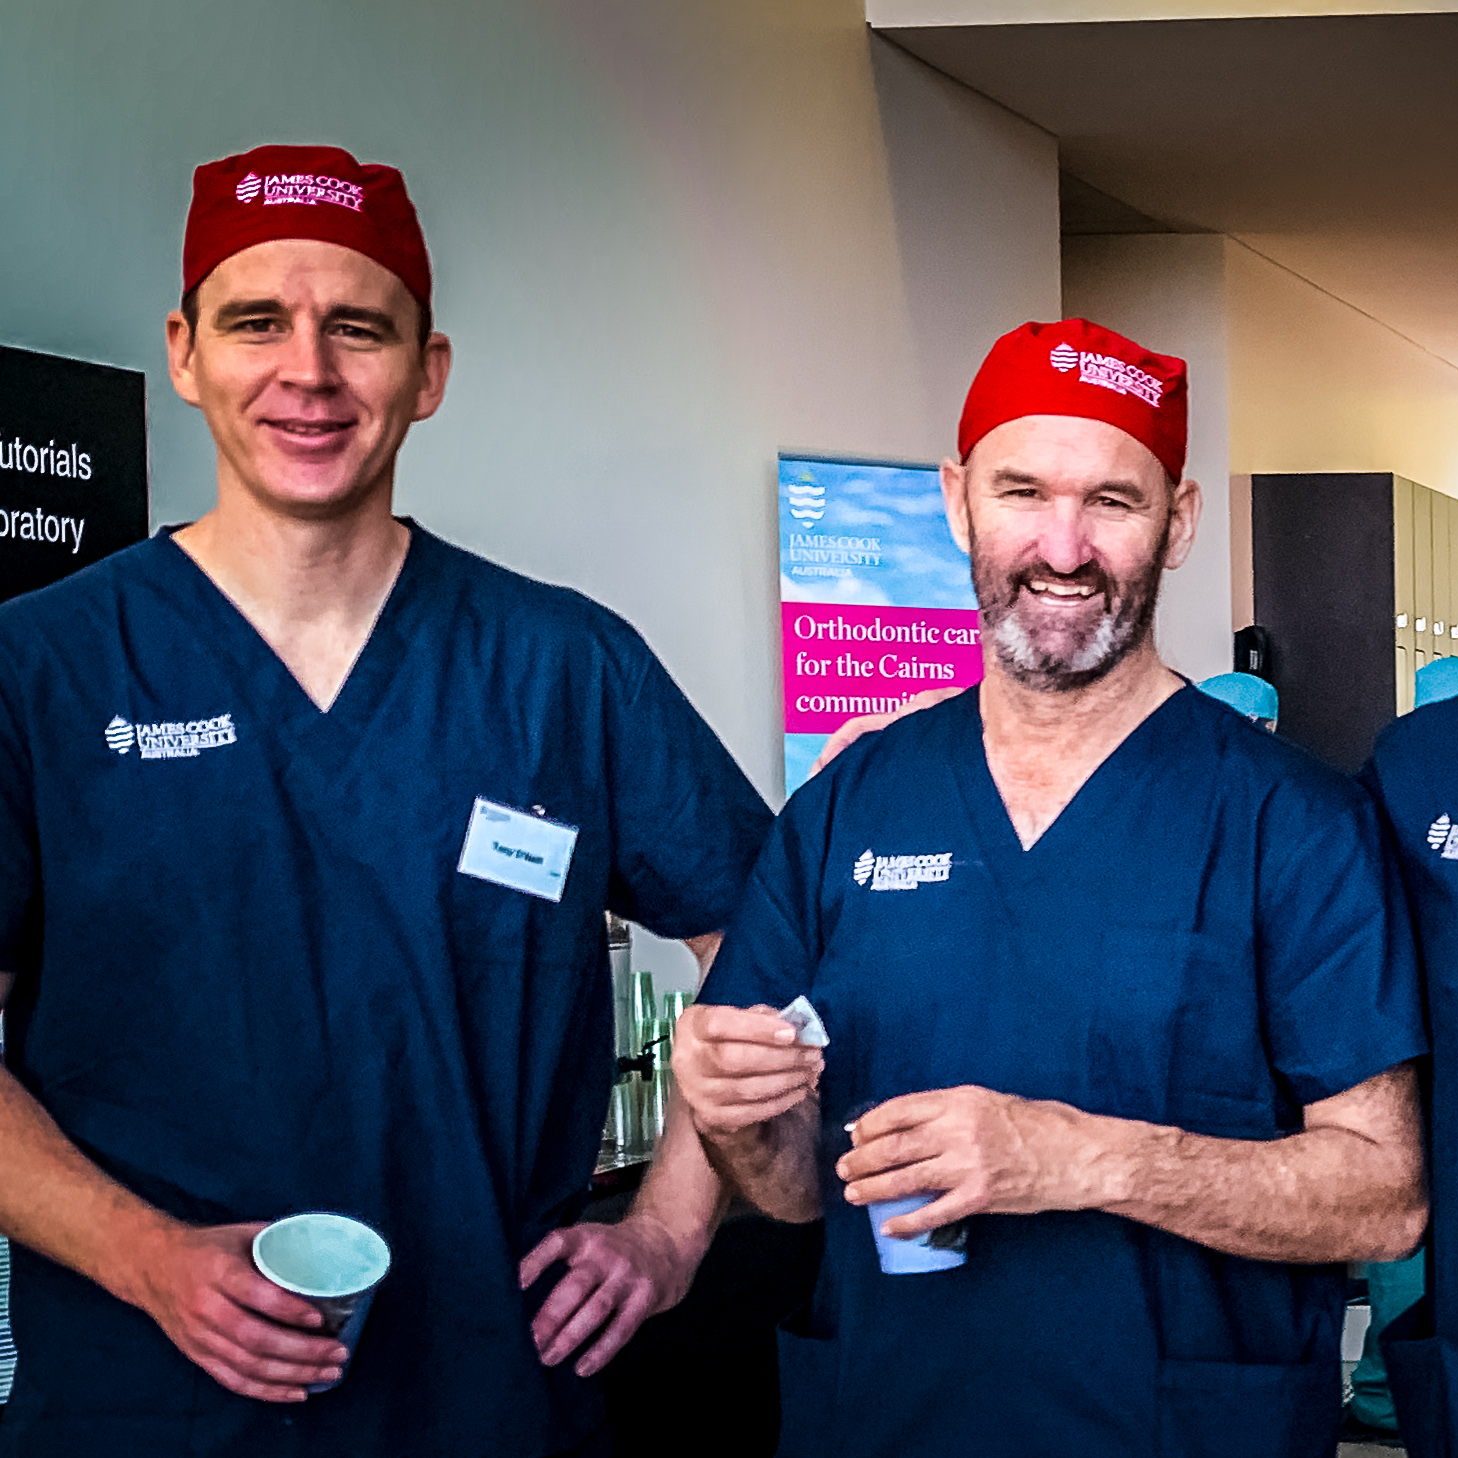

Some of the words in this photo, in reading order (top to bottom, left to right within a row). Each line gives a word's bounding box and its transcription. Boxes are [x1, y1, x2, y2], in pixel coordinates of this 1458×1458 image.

[265, 174, 314, 186] JAMES
[316, 176, 363, 194] COOK
[264, 185, 363, 209] UNIVERSITY
[790, 534, 837, 548] JAMES
[839, 536, 881, 551] COOK
[790, 548, 882, 565] UNIVERSITY
[791, 566, 853, 577] AUSTRALIA
[794, 615, 940, 644] Orthodontic
[796, 651, 832, 676] for
[836, 652, 875, 677] the
[878, 653, 955, 680] Cairns
